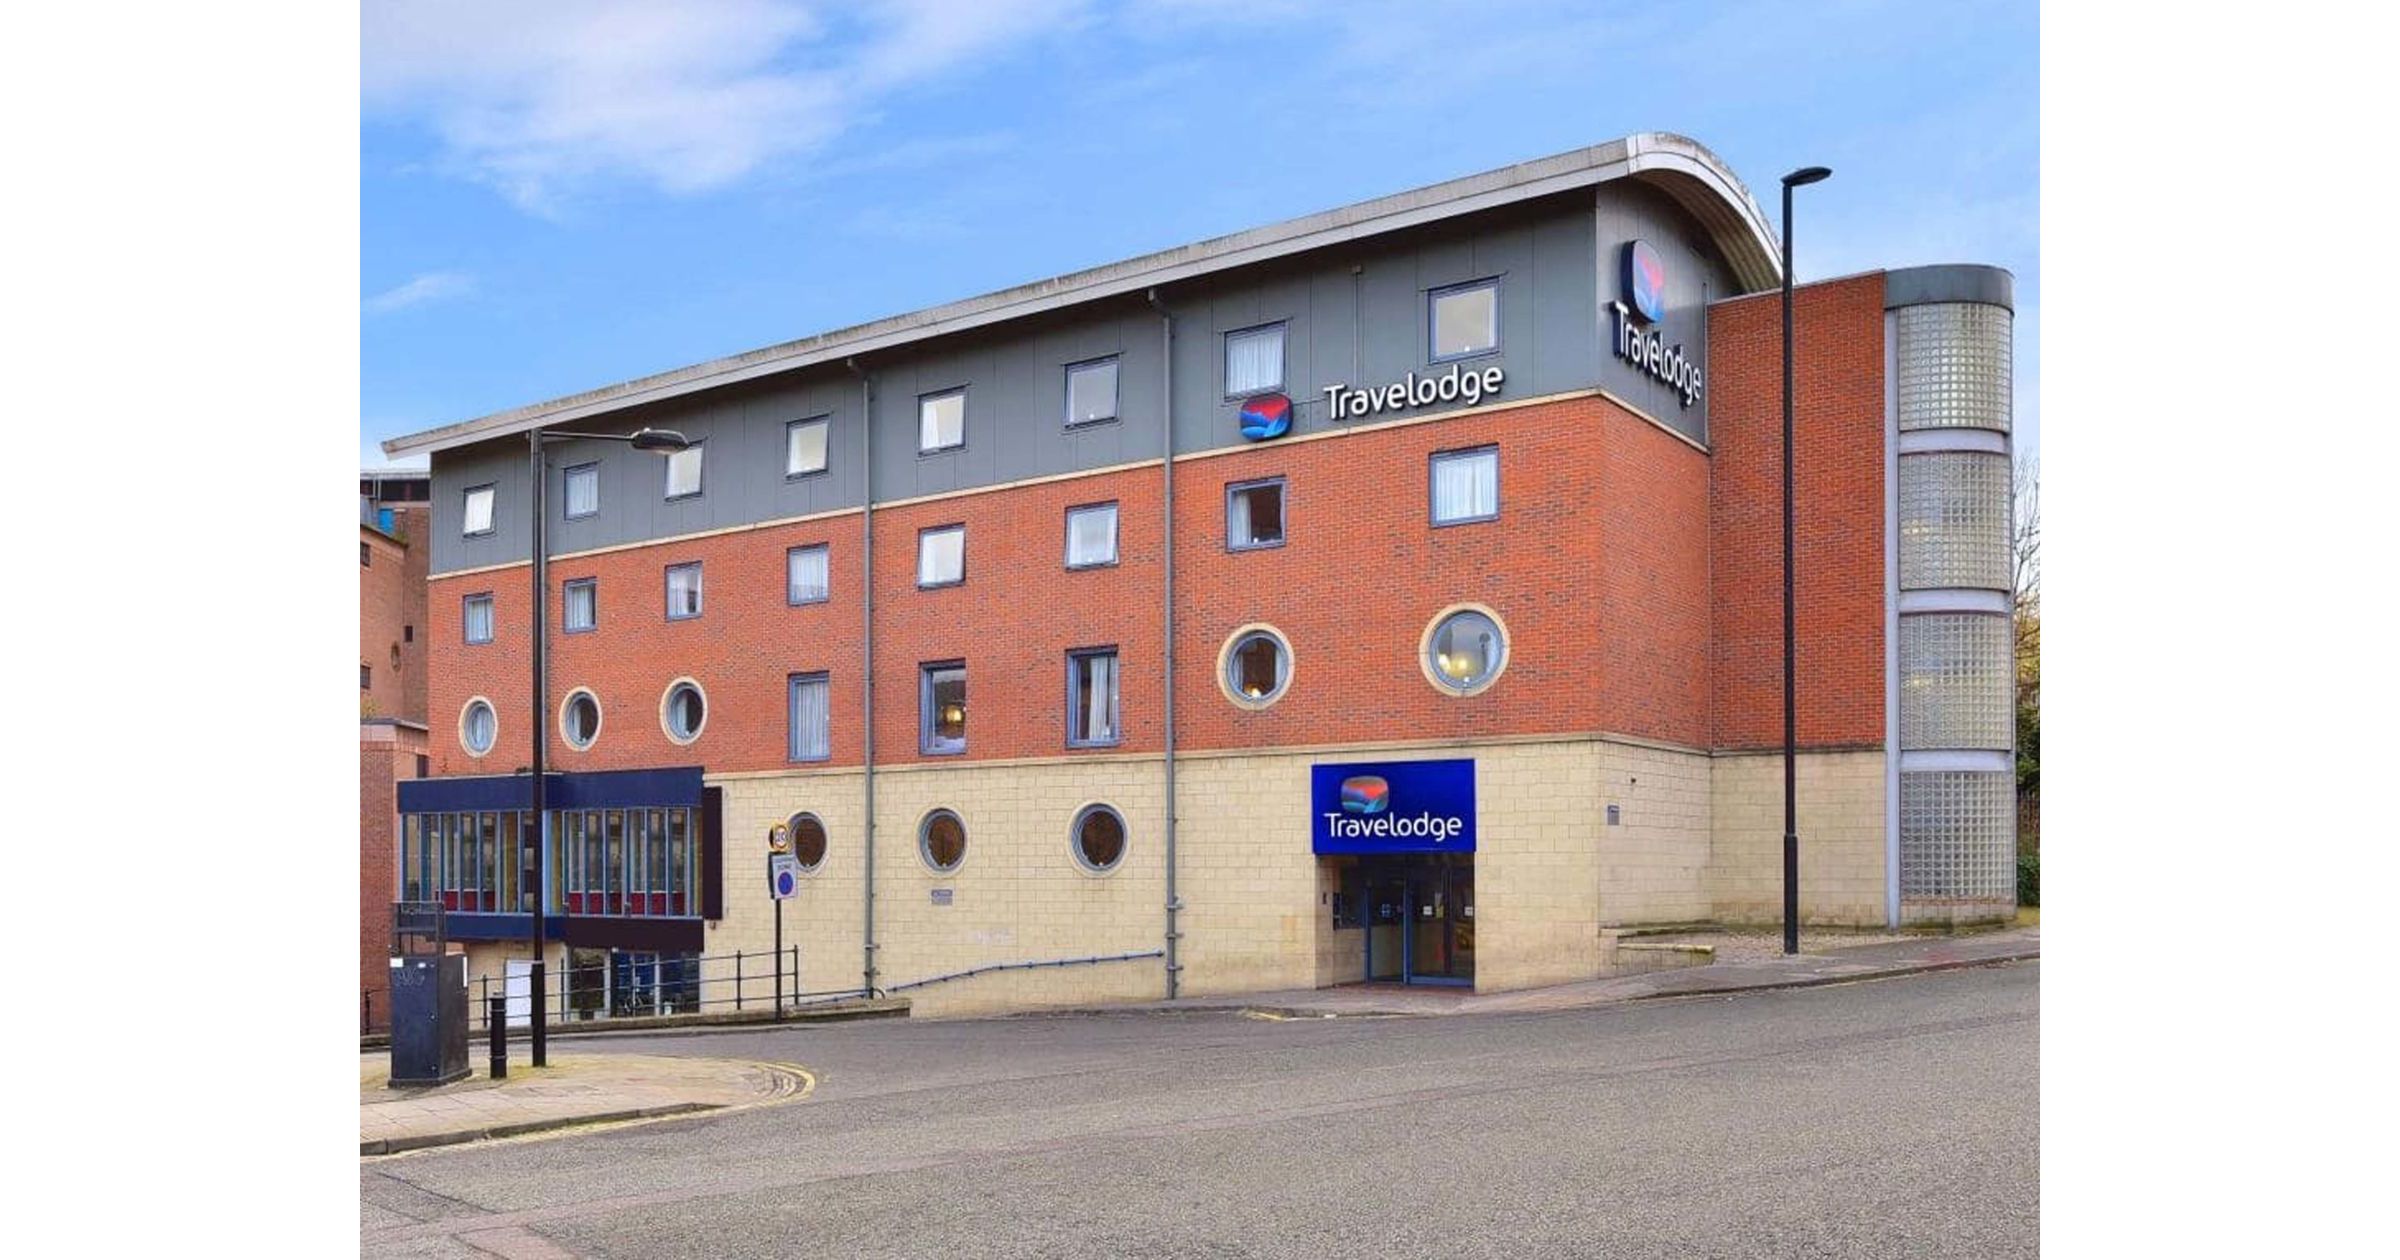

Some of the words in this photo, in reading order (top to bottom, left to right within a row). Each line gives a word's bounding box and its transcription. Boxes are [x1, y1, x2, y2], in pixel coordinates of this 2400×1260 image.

[1612, 302, 1702, 406] Travelodge
[1324, 364, 1504, 420] Travelodge
[1324, 812, 1462, 842] Travelodge
